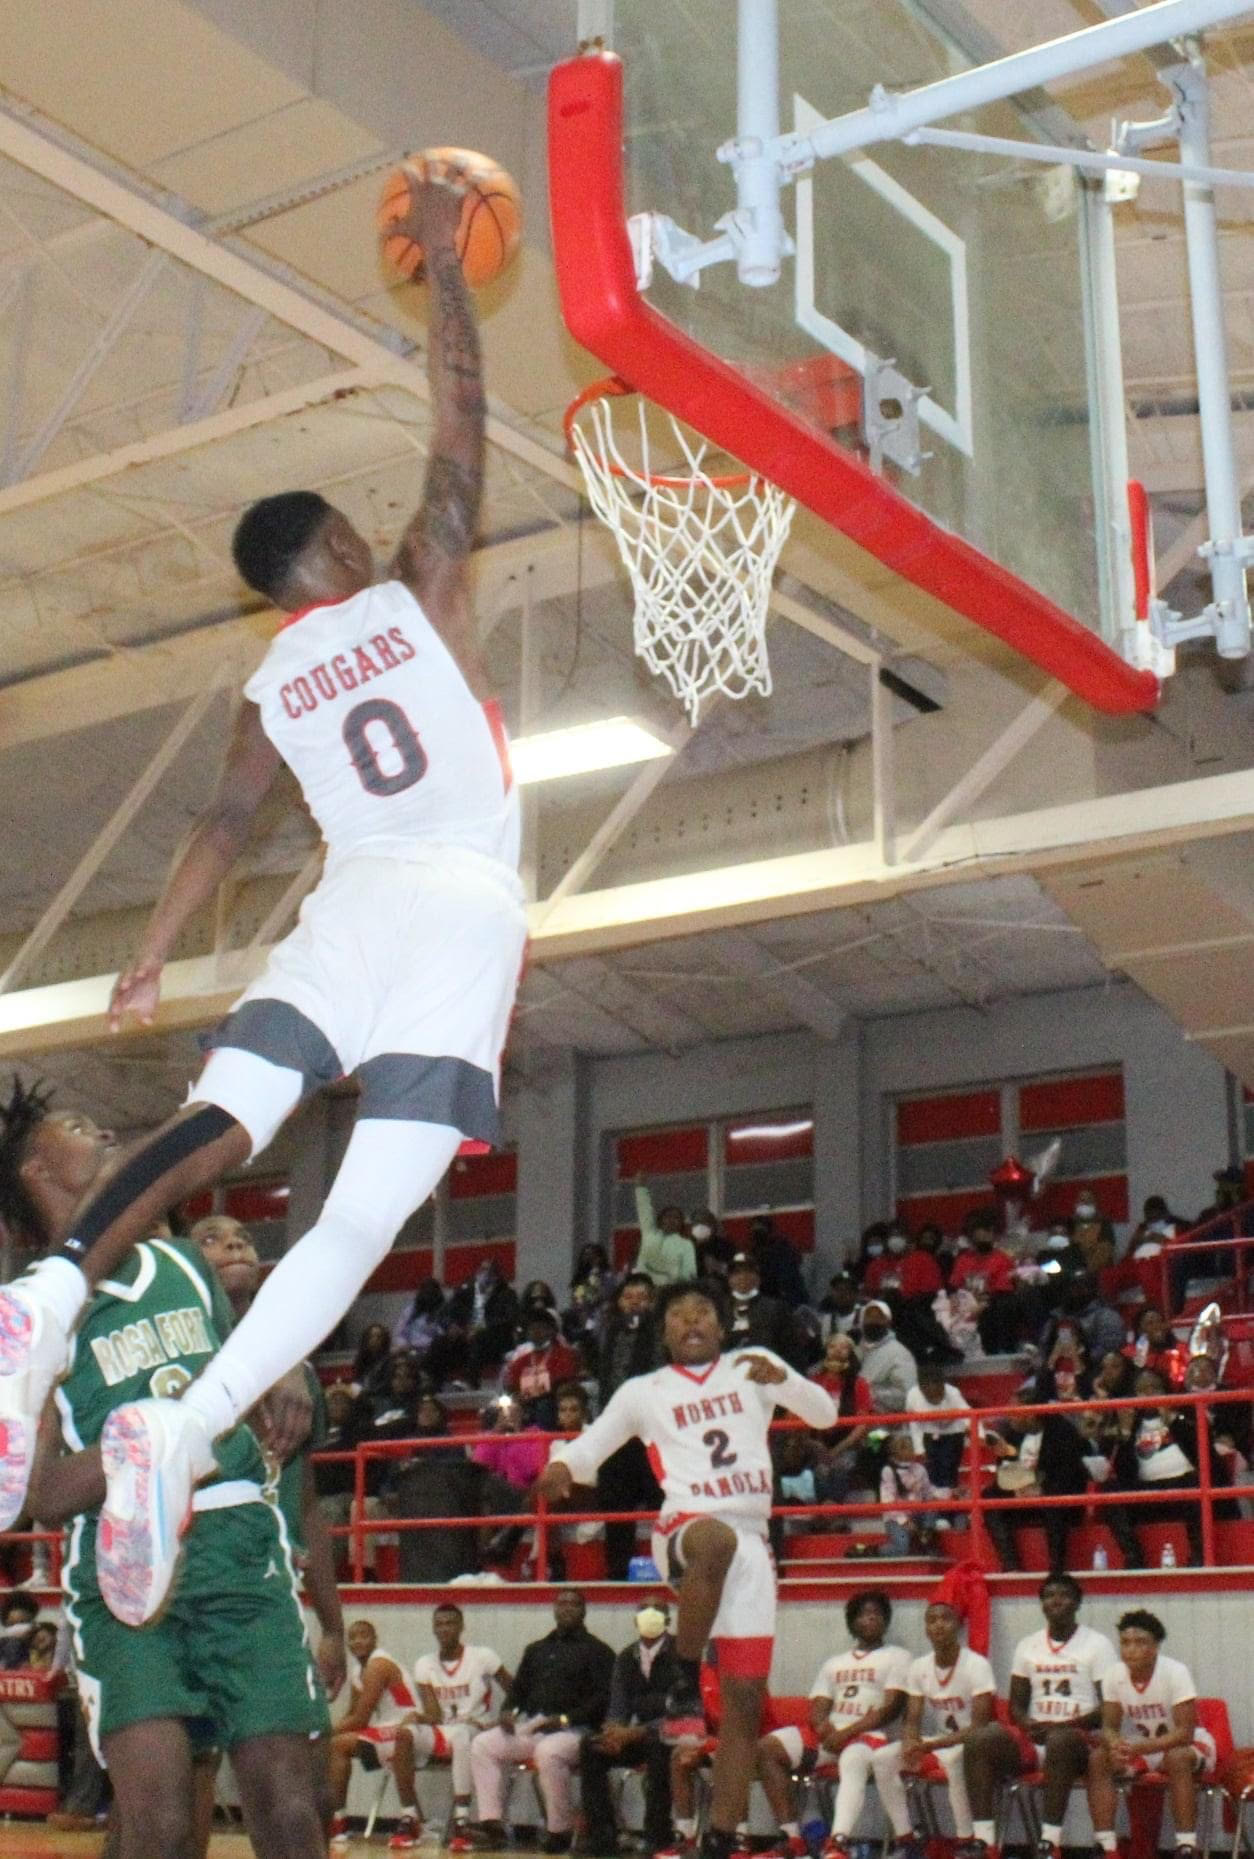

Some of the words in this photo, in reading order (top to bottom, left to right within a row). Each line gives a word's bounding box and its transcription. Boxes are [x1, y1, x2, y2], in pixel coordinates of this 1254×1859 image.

[279, 626, 416, 719] COUGARS
[341, 697, 428, 797] 0
[90, 1318, 168, 1386] ROSA
[671, 1391, 744, 1430] NORTH
[702, 1428, 738, 1469] 2
[1042, 1678, 1072, 1697] 14
